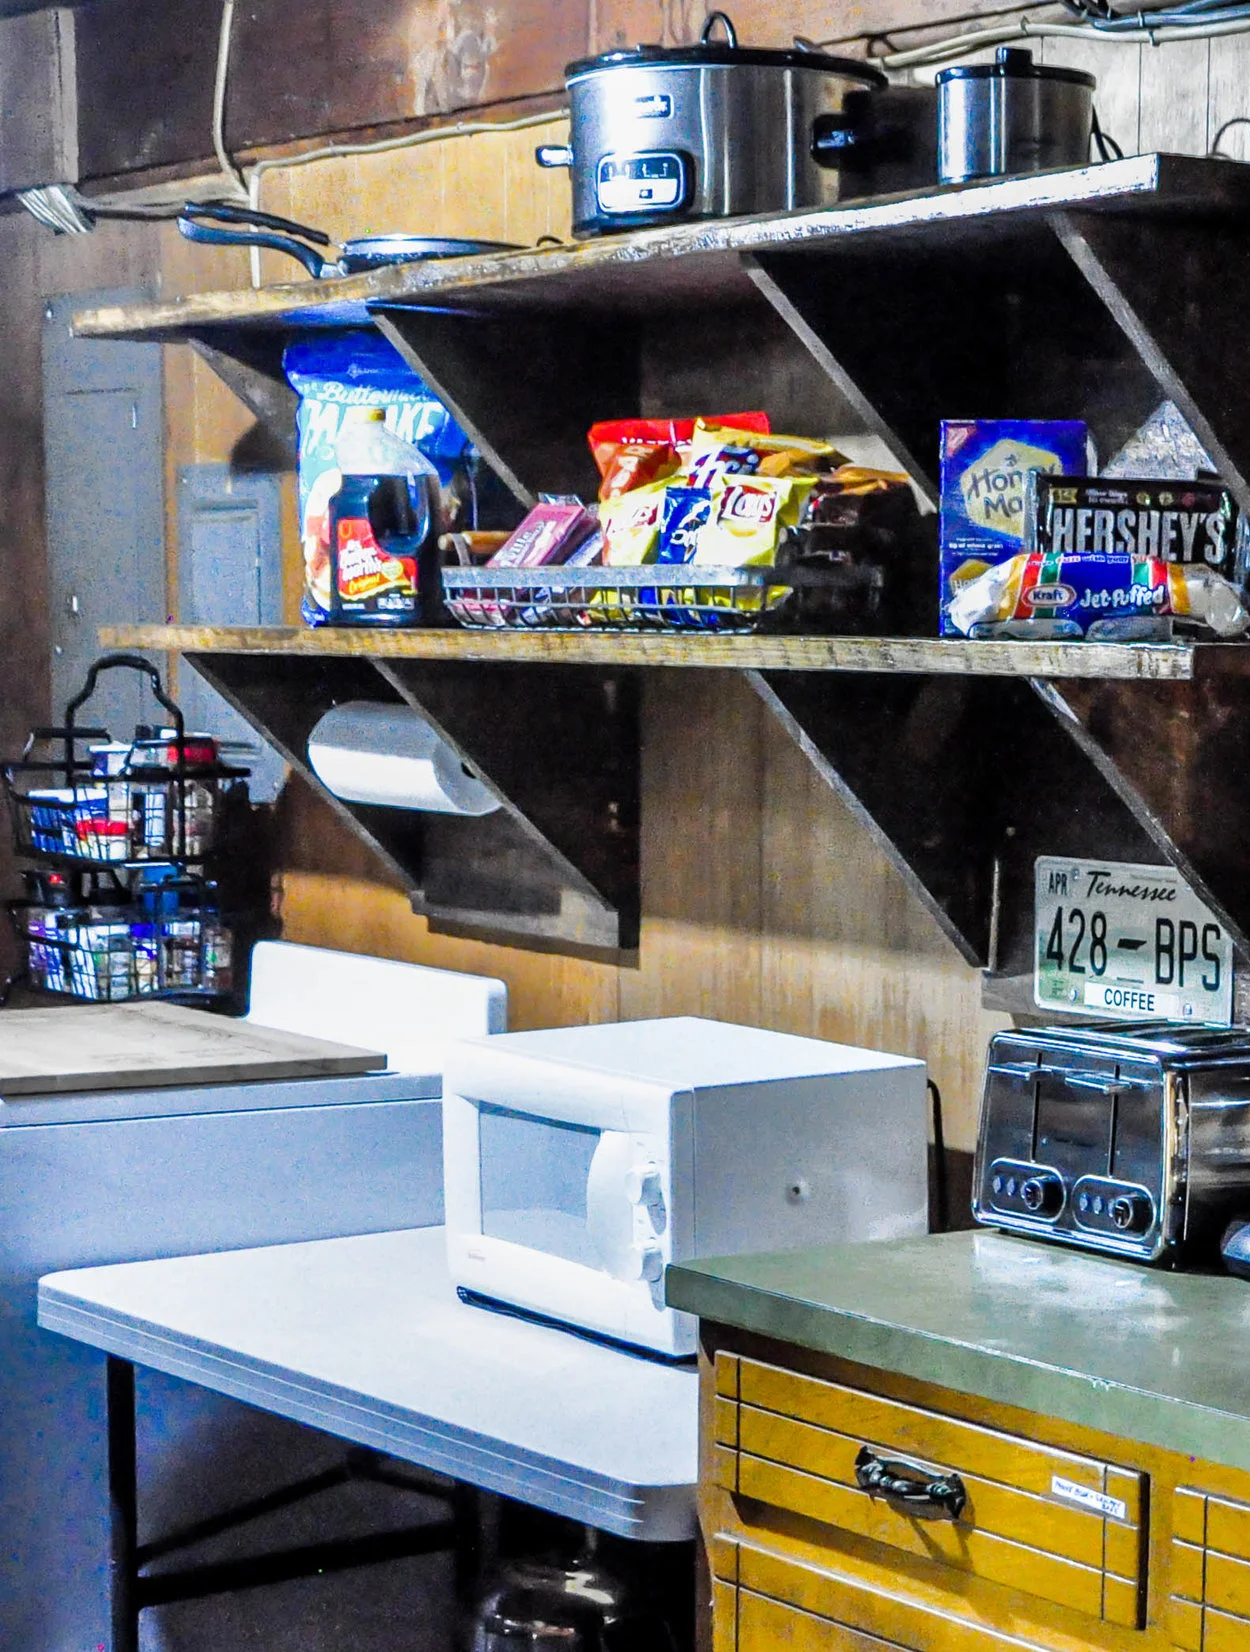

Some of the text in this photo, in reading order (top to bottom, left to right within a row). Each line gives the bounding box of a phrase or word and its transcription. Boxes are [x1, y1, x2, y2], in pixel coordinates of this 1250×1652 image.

[983, 493, 1023, 520] Ma
[1052, 508, 1227, 565] HERSHEY'S
[1033, 589, 1064, 600] Kraft
[1049, 870, 1177, 901] APR Tennessee
[1047, 906, 1221, 992] 428 BPS
[1104, 988, 1155, 1012] COFFEE
